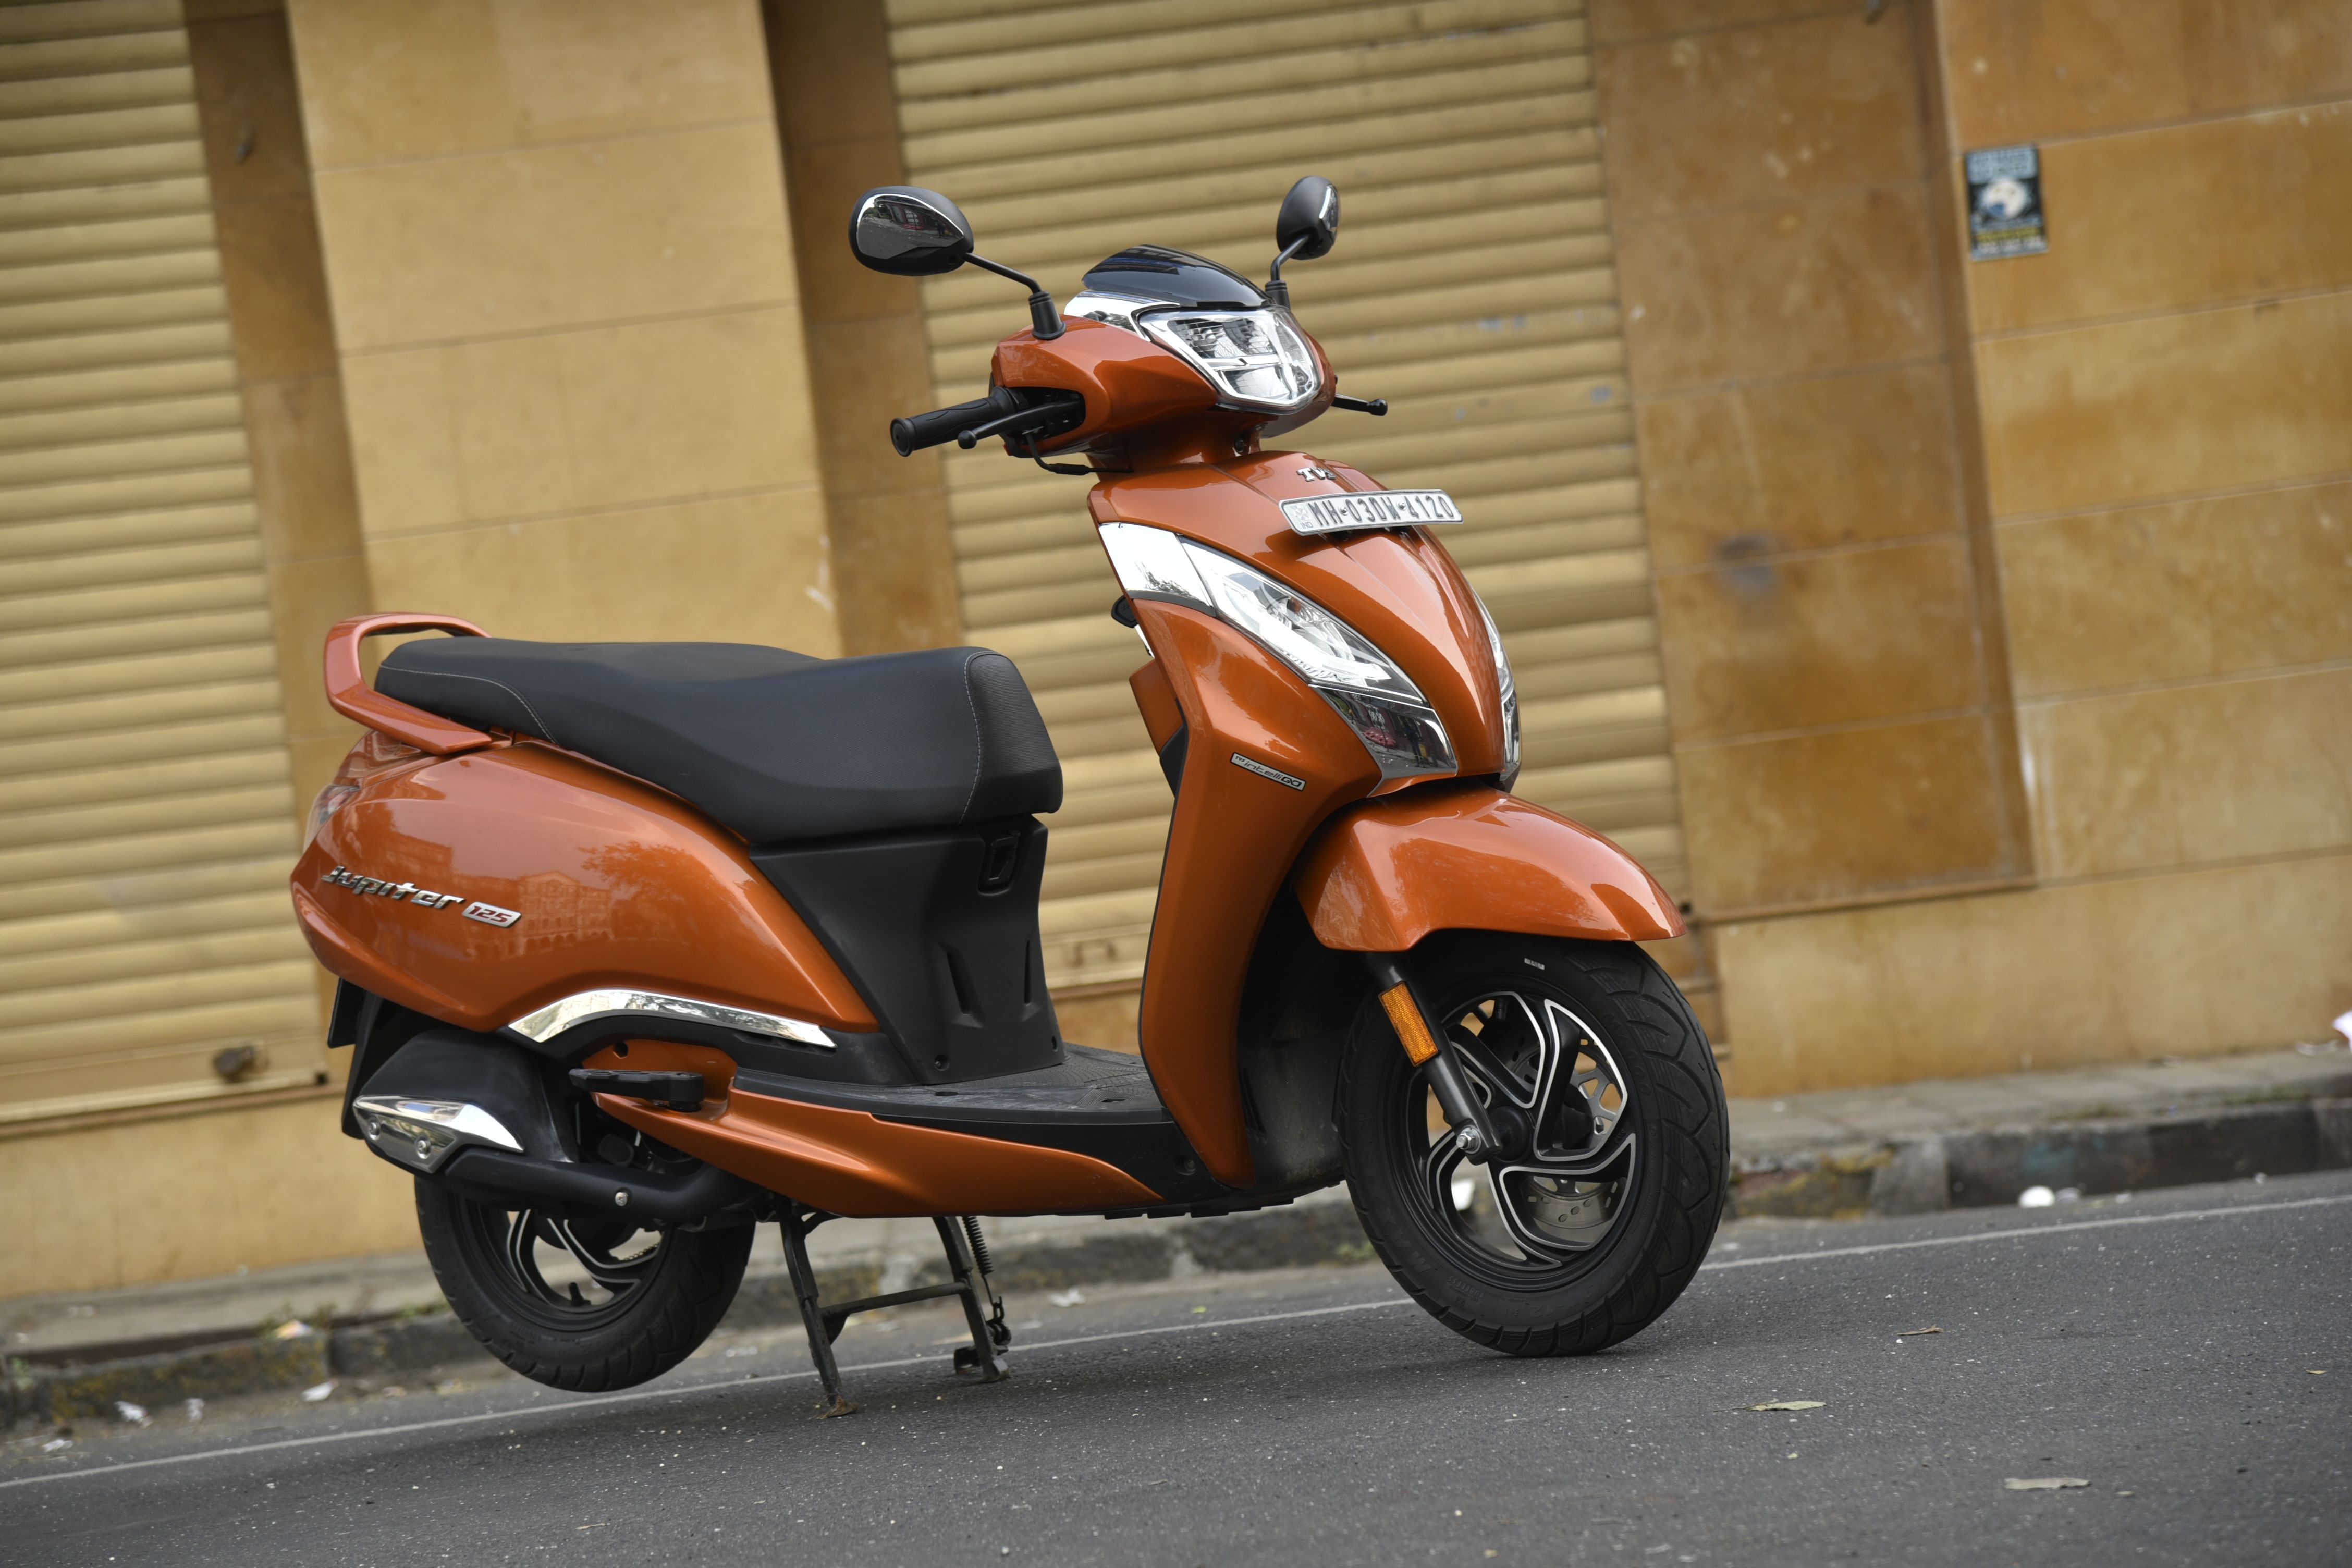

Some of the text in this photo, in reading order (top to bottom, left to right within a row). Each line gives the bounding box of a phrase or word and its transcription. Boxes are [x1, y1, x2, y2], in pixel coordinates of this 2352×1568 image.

[1296, 467, 1336, 482] TVS
[1308, 495, 1454, 527] MH 03DW 4120
[322, 865, 512, 924] Jupiter 125
